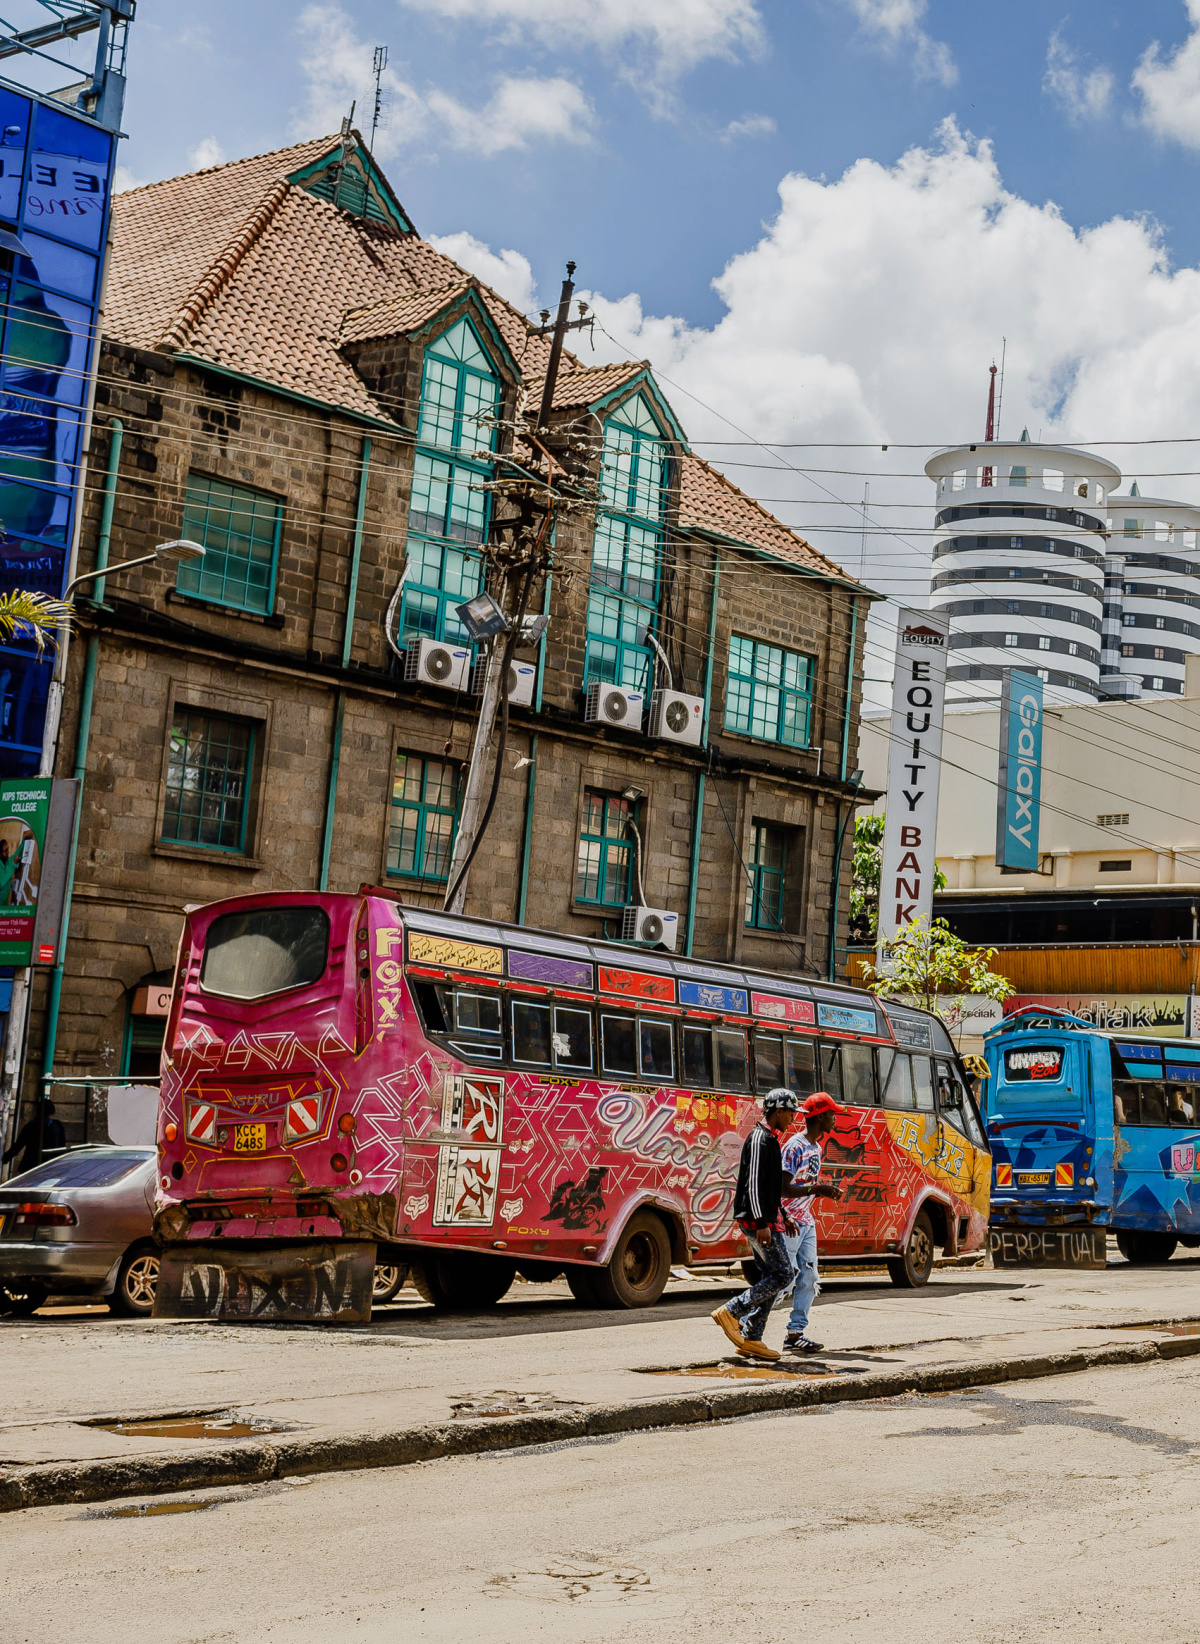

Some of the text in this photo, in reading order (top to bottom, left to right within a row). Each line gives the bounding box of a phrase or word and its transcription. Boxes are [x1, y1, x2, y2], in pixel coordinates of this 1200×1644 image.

[903, 634, 944, 646] EQUITY
[902, 661, 933, 812] EQUITY
[1008, 694, 1039, 849] Galaxy
[16, 790, 48, 801] TECHNICAL
[11, 802, 38, 813] COLLEGE
[895, 825, 922, 925] BANK
[960, 1009, 996, 1019] zodiak
[231, 1093, 280, 1108] ISUZU
[236, 1125, 257, 1137] KCC
[506, 1226, 551, 1236] FOXY
[990, 1231, 1106, 1263] PERPETUAL
